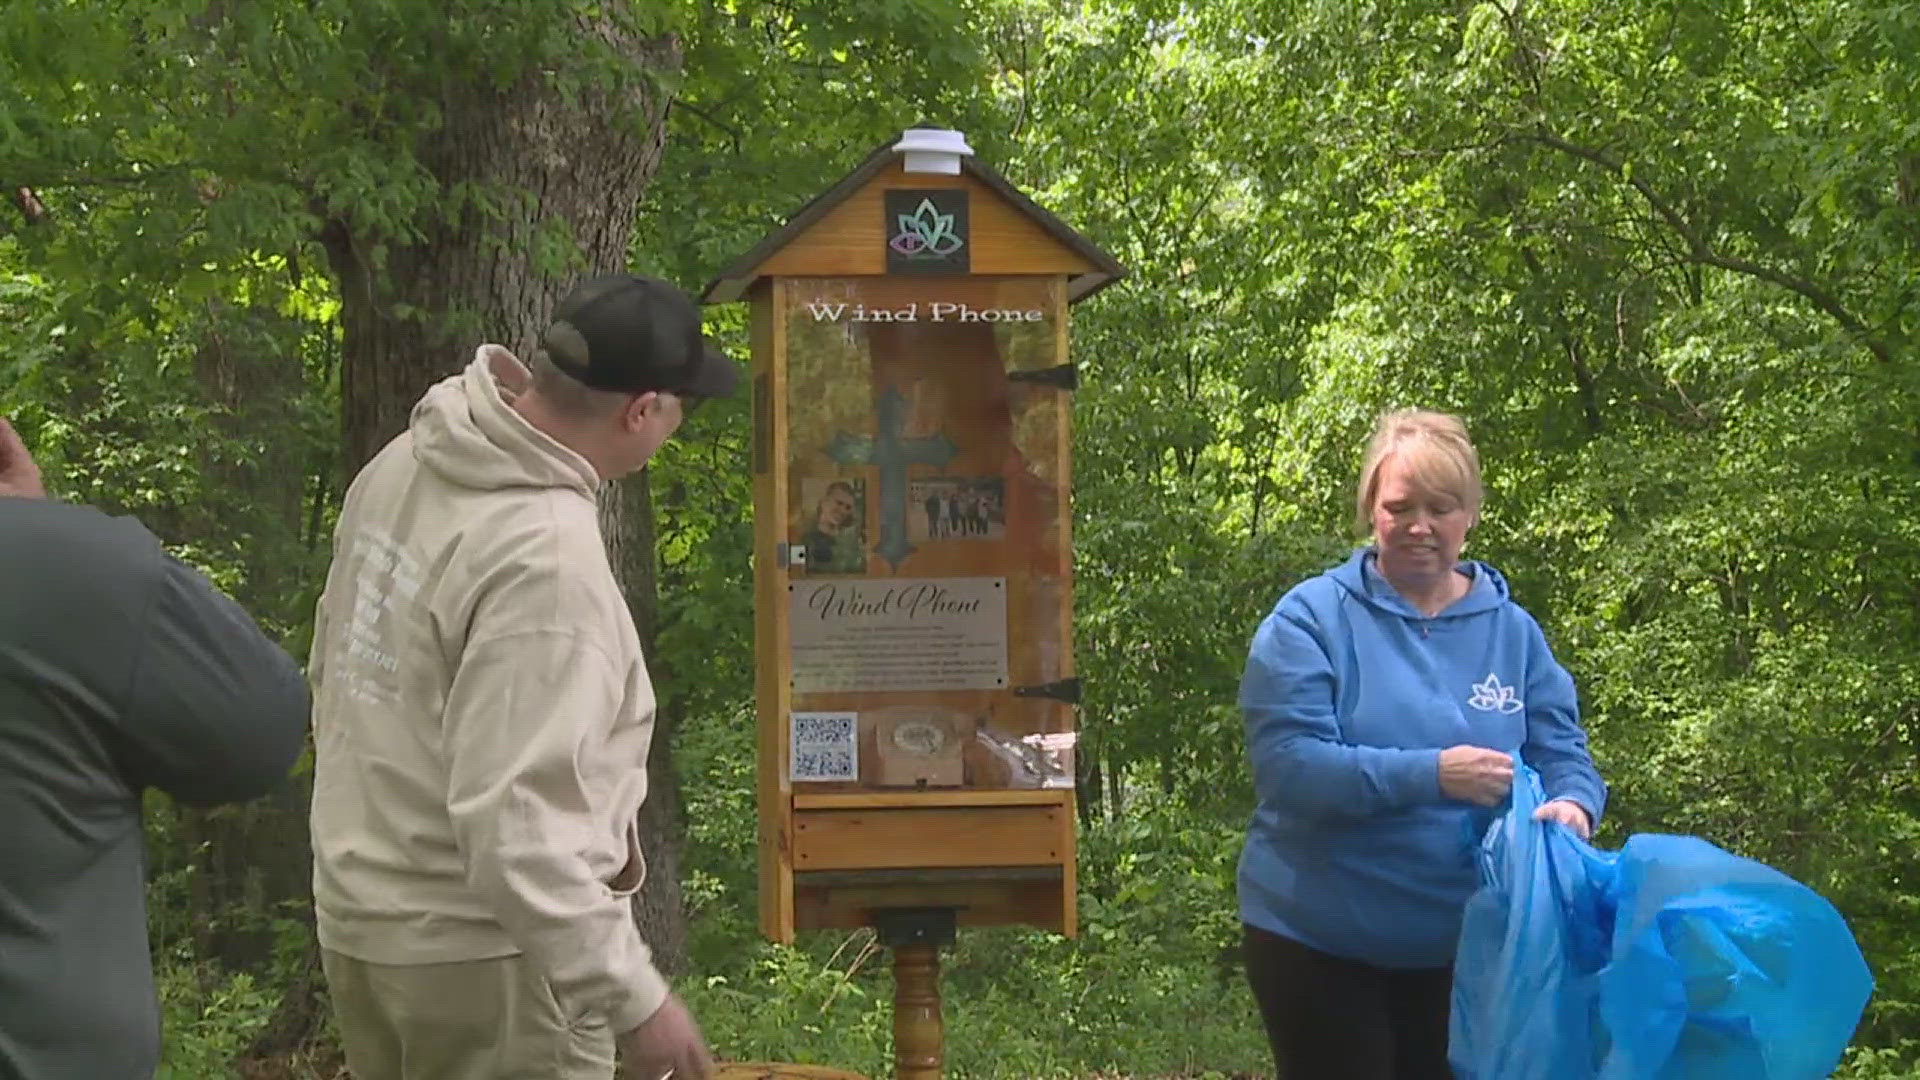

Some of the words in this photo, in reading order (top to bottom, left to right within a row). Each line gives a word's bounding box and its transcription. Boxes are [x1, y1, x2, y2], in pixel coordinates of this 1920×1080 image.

[809, 303, 918, 322] Wind
[930, 303, 1043, 322] Phone
[809, 583, 894, 620] Wind
[897, 583, 980, 619] Phone
